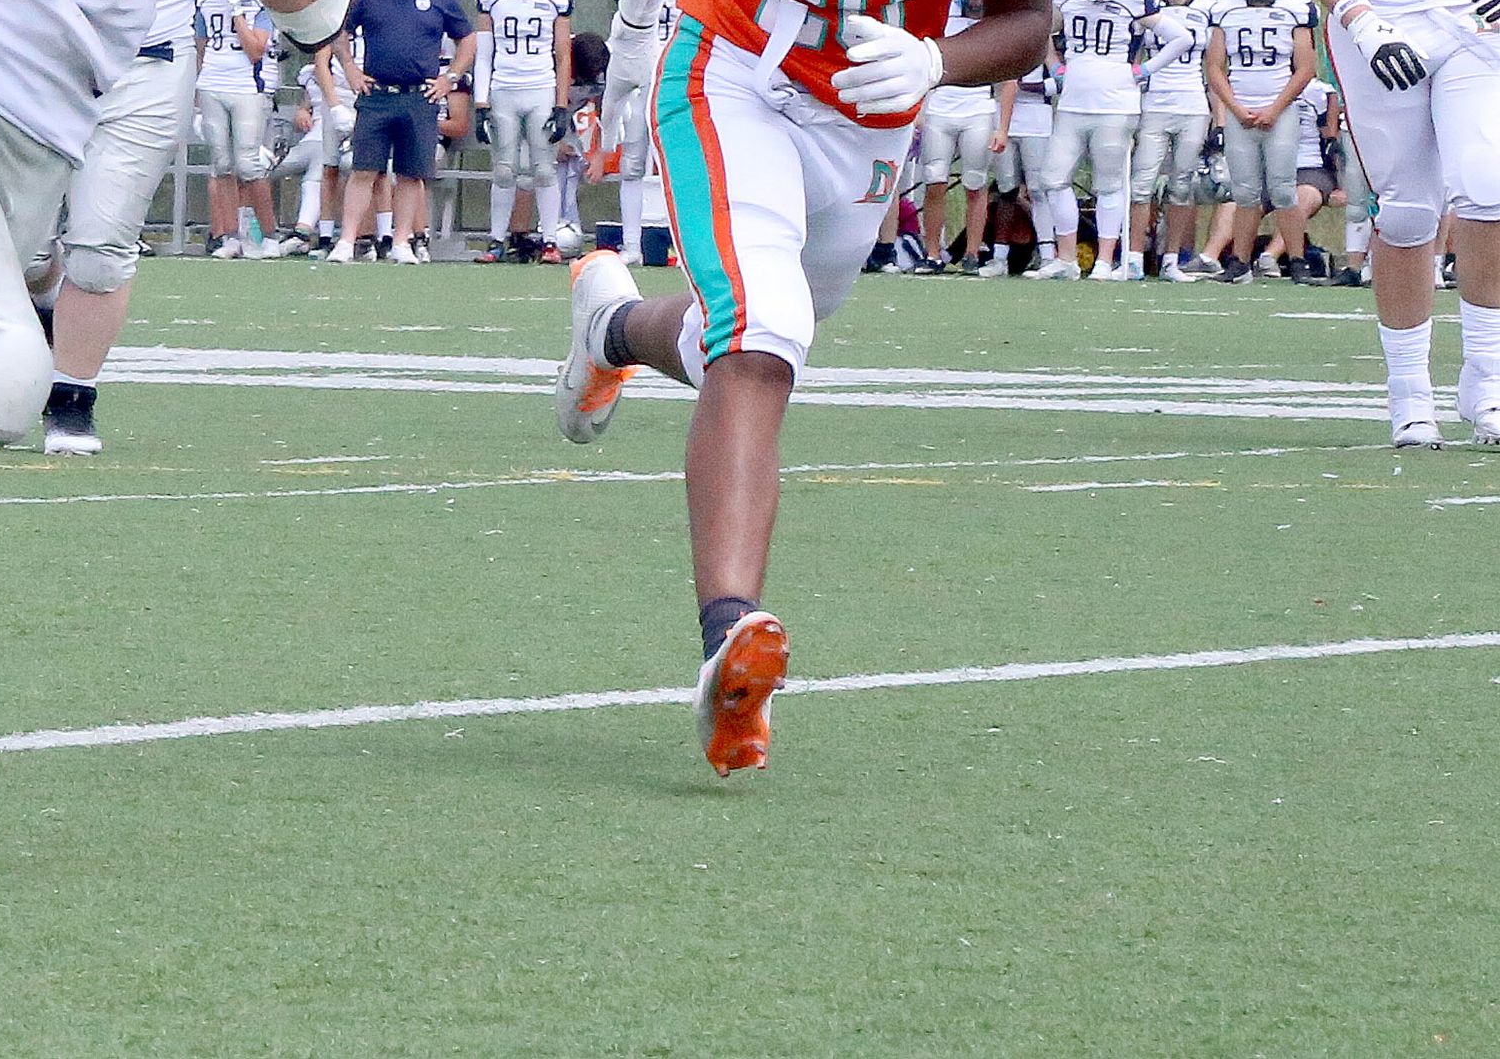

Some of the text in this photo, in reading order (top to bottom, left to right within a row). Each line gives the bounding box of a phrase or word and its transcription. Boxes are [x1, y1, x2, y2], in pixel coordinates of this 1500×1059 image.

[504, 16, 542, 55] 92
[1071, 15, 1114, 56] 90
[1238, 27, 1278, 67] 65
